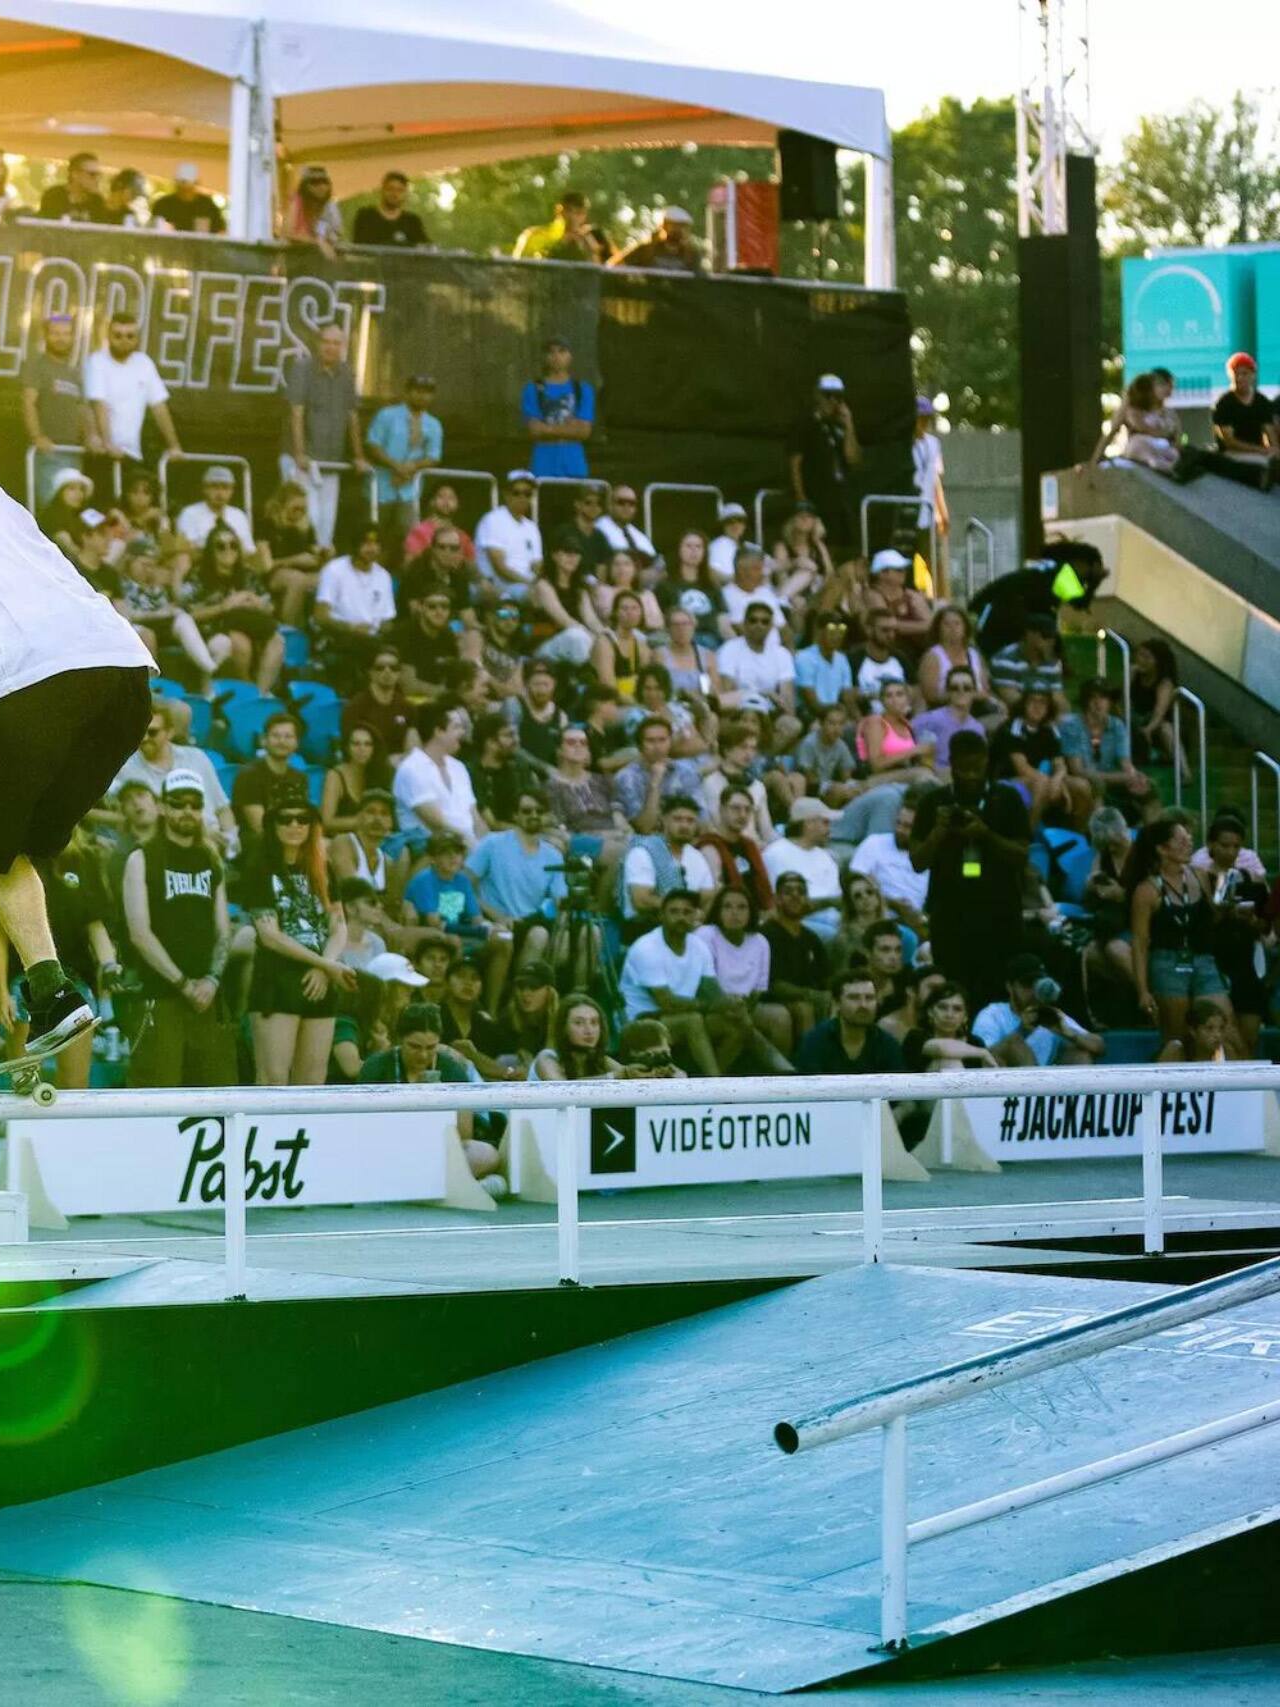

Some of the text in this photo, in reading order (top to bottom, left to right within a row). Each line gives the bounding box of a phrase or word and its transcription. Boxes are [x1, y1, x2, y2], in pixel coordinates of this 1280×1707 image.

[649, 1108, 811, 1154] VIDÉOTRON
[1000, 1091, 1215, 1142] #JACKALOPFEST
[178, 1116, 310, 1203] Pabst
